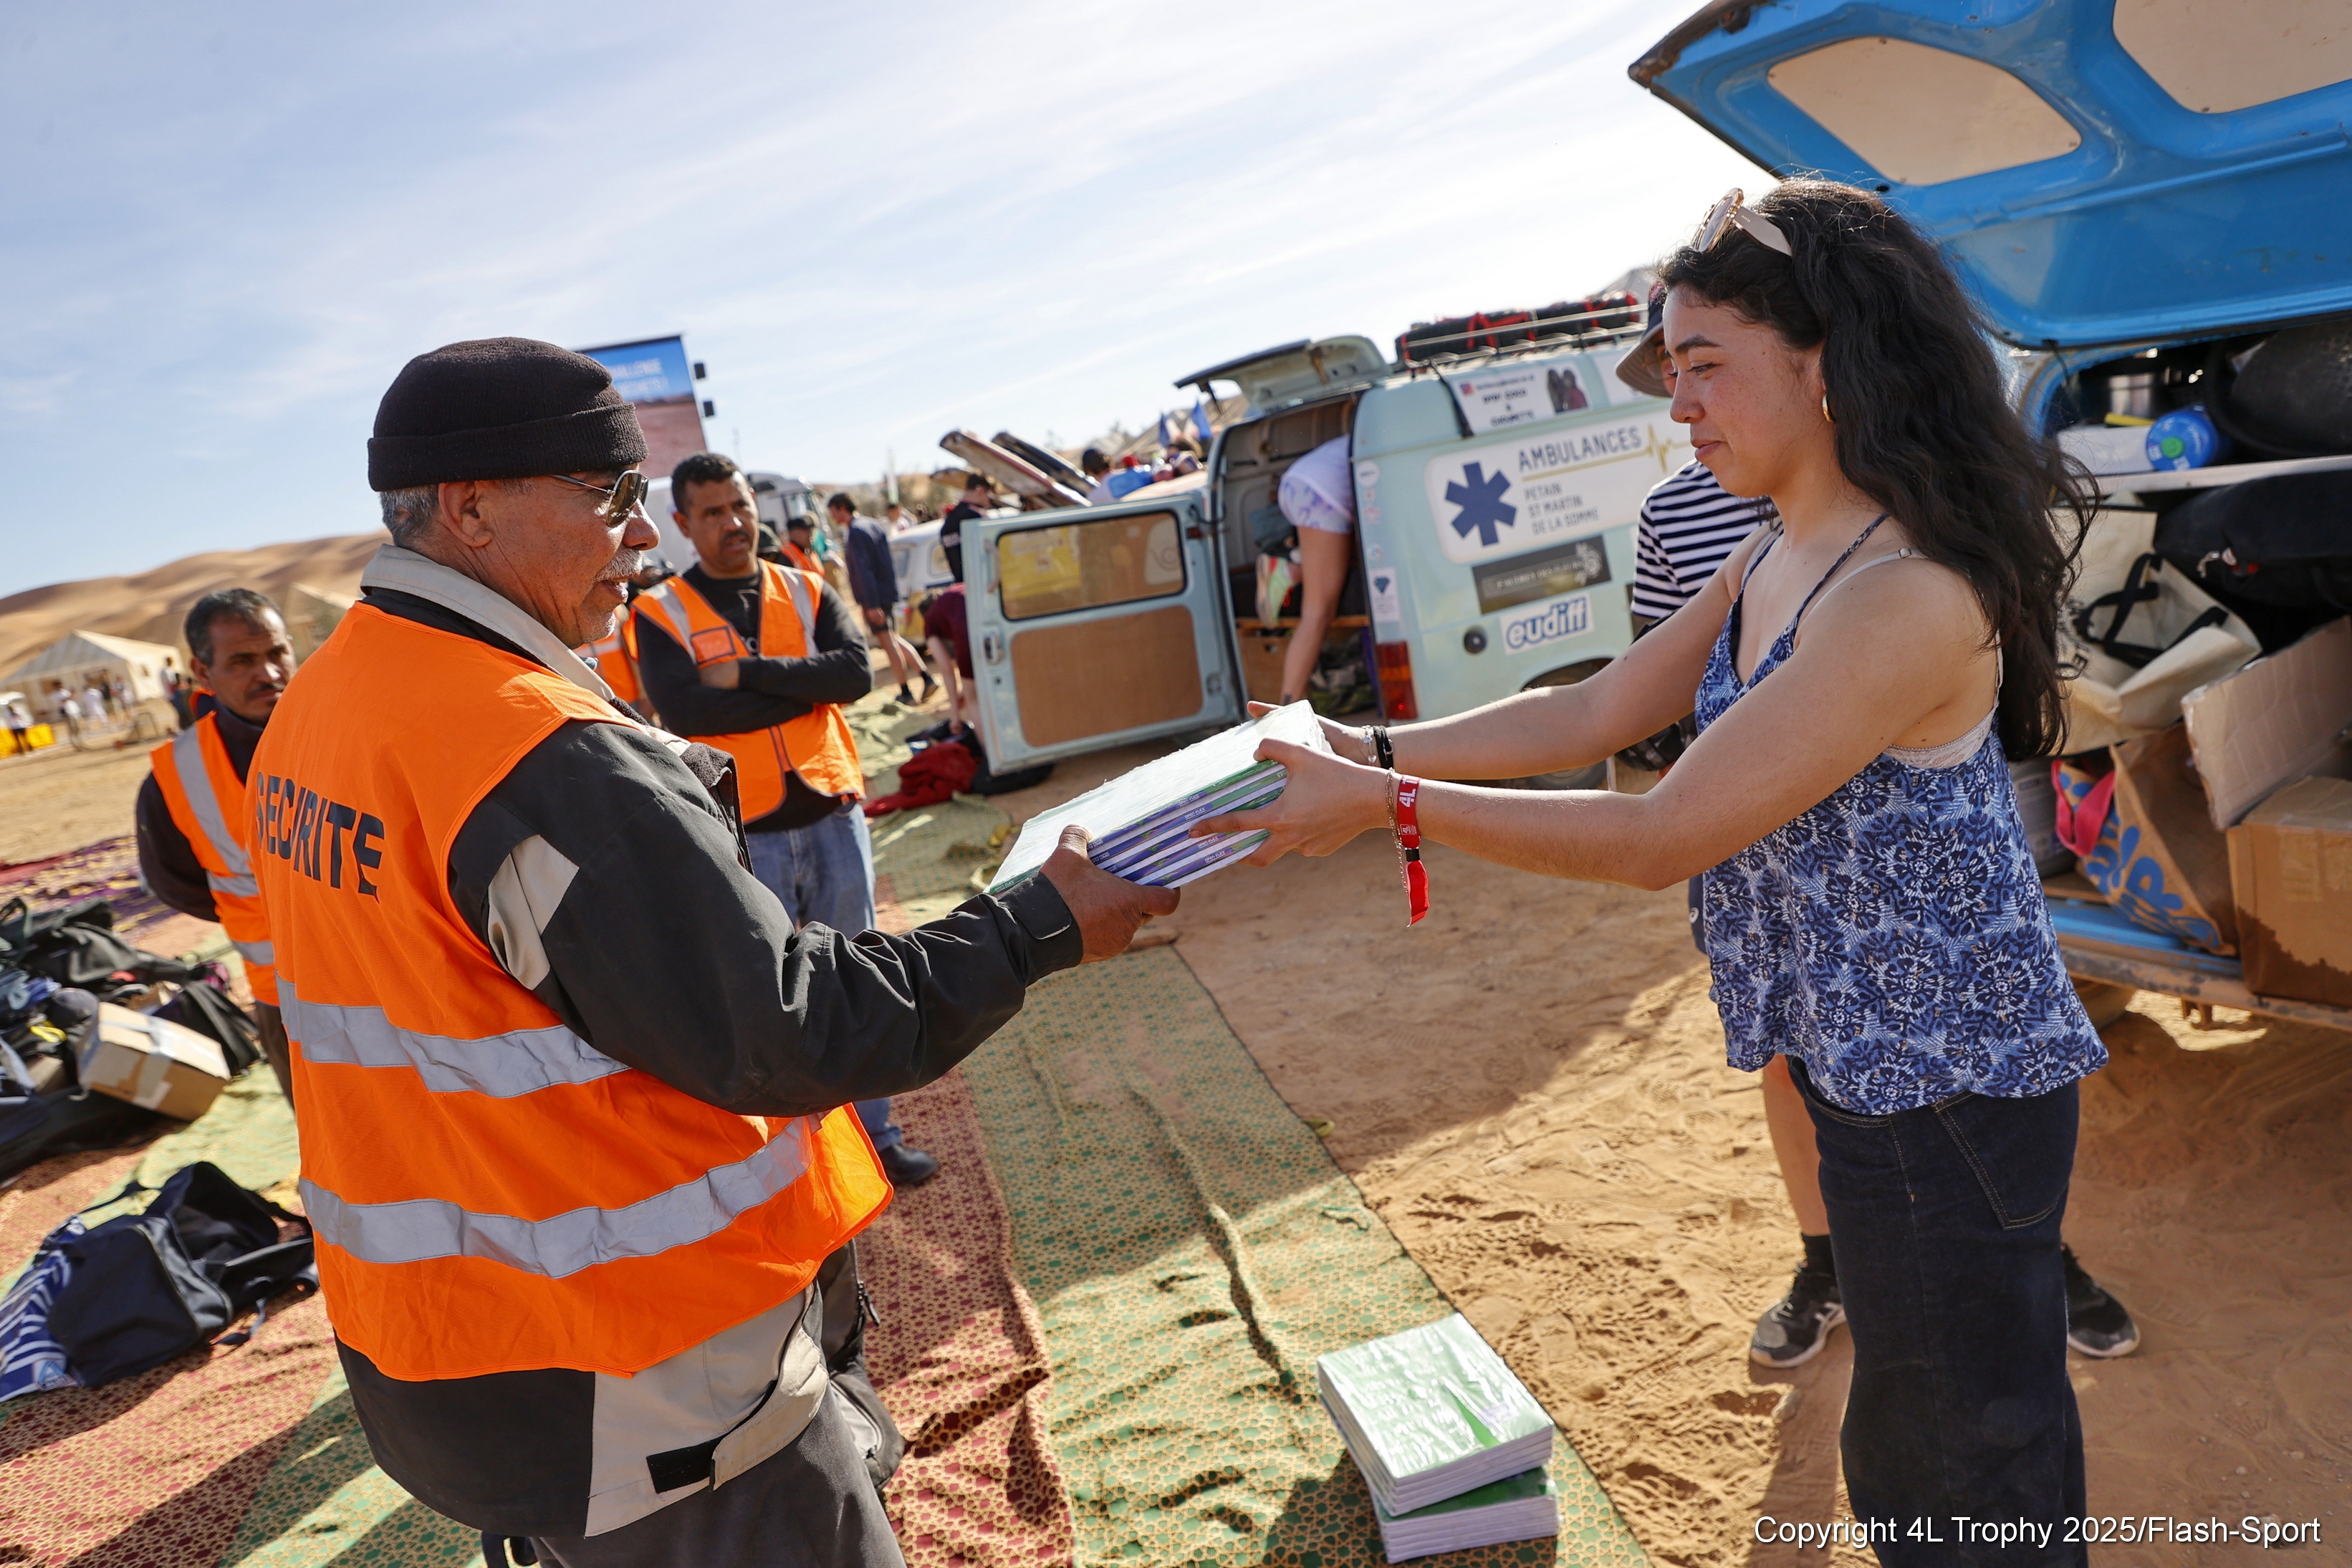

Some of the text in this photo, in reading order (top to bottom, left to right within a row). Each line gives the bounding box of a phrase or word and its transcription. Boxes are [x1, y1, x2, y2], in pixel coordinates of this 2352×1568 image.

[1518, 425, 1642, 473] AMBULANCES
[1543, 494, 1583, 514] MARTIN
[1507, 597, 1586, 649] eudiff
[1399, 789, 1416, 807] 4L
[1204, 850, 1226, 865] OPEN FLEX
